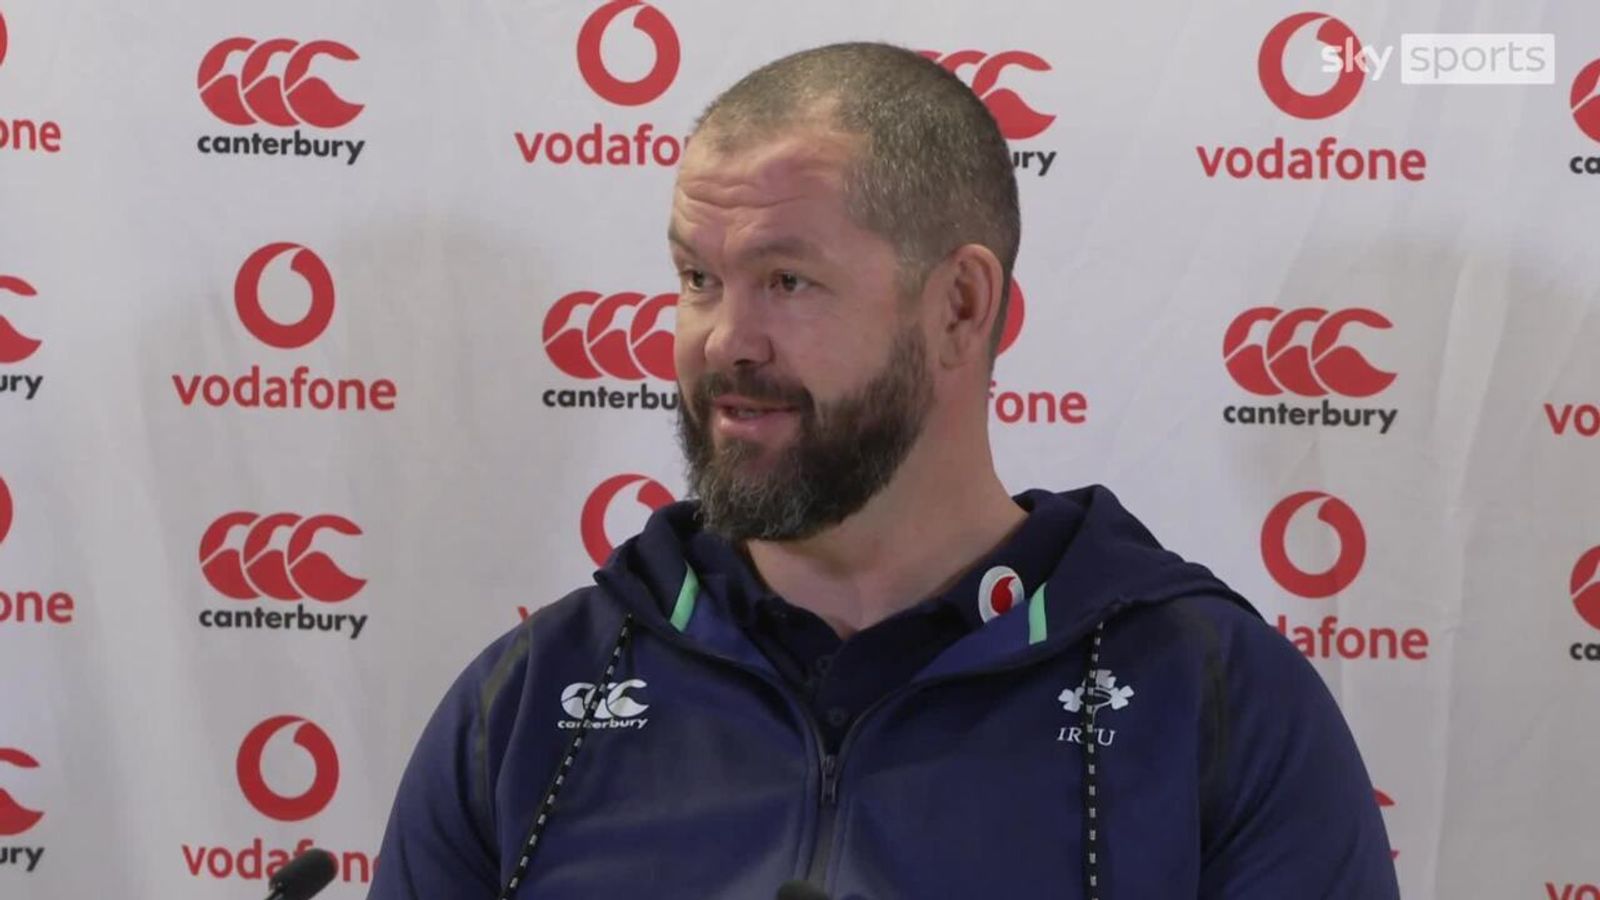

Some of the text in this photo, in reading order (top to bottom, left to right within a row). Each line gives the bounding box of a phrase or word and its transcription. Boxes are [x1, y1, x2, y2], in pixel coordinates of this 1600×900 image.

[197, 129, 366, 166] canterbury
[515, 121, 690, 168] vodafo
[1196, 136, 1427, 182] vodafone
[173, 364, 398, 412] vodafone
[988, 380, 1088, 425] one
[1223, 399, 1399, 435] canterbury
[199, 603, 368, 641] canterbury
[1056, 726, 1116, 747] IRU
[181, 837, 381, 883] vodan
